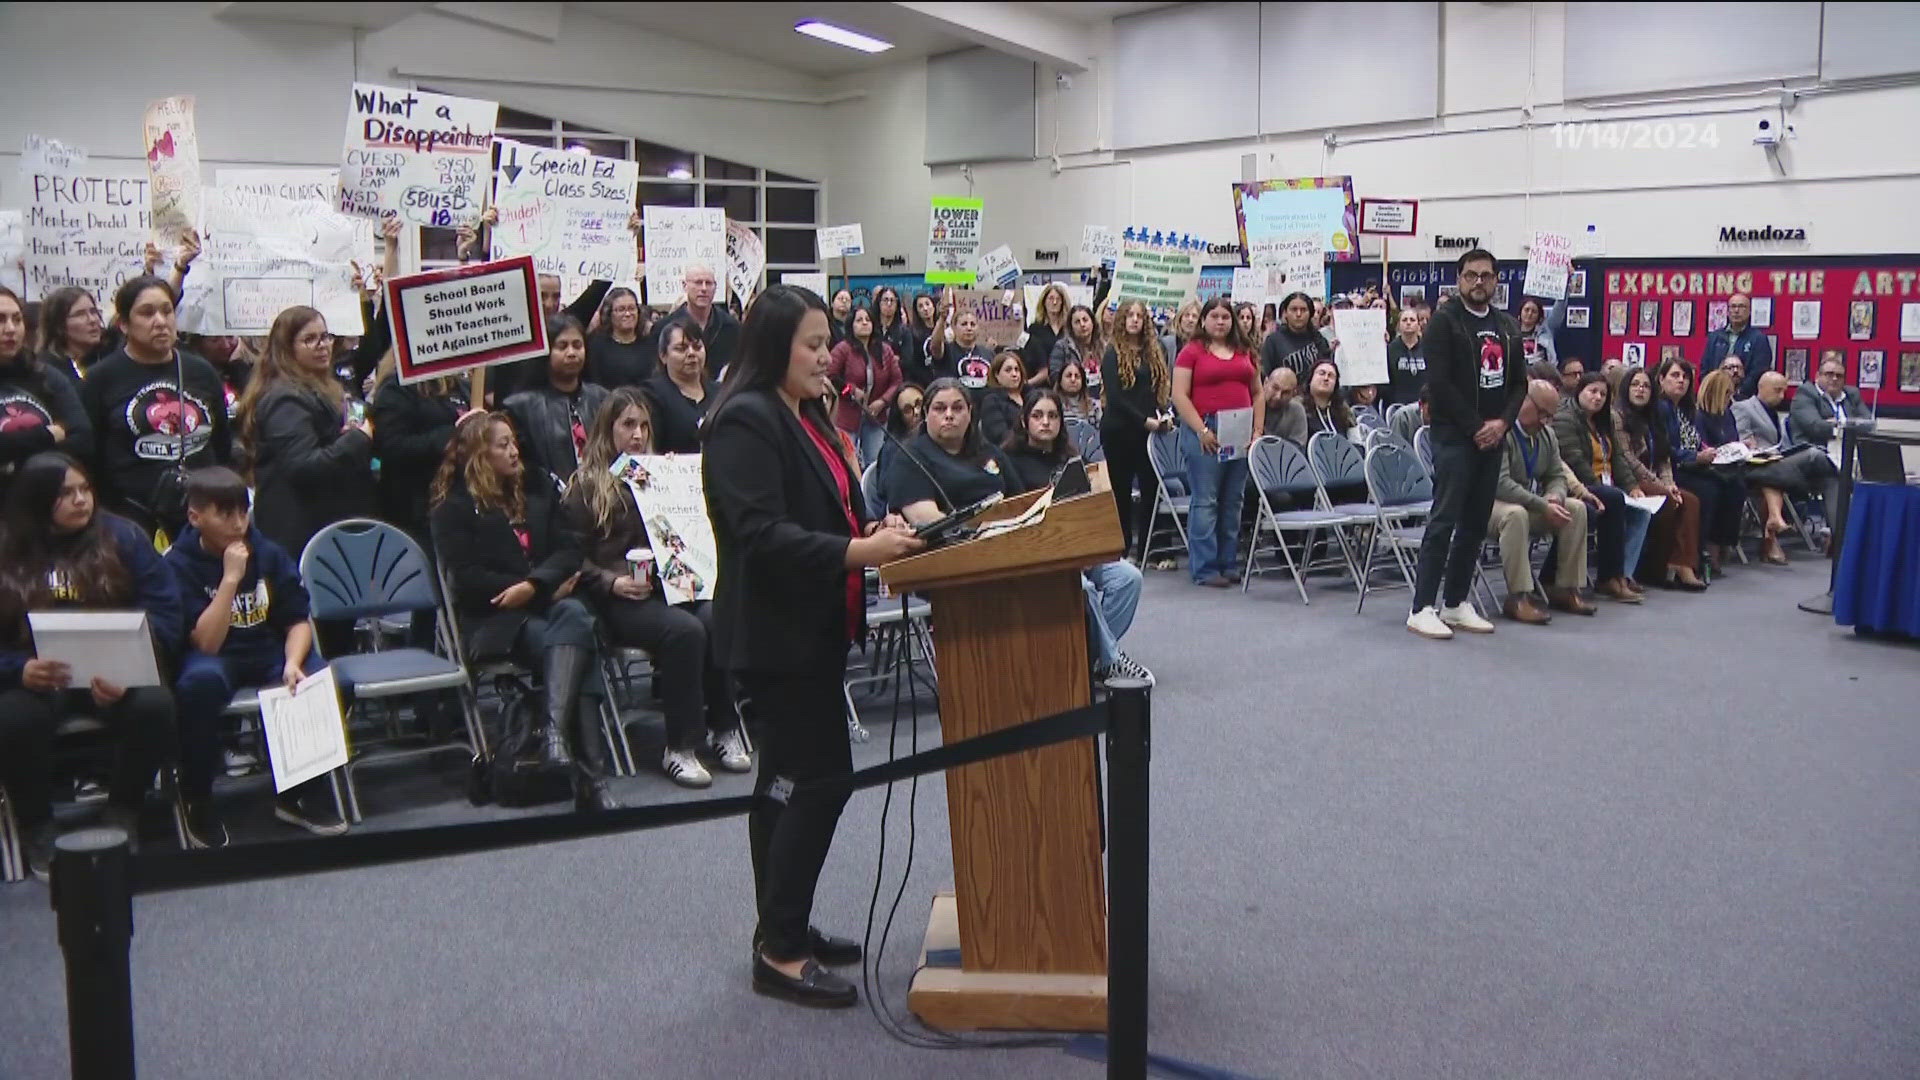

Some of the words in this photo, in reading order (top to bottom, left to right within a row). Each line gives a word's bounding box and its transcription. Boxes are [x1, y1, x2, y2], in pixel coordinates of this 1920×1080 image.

[354, 89, 418, 119] What
[435, 105, 452, 121] a
[364, 118, 494, 153] Disappointment
[347, 150, 406, 166] CVESD
[530, 152, 586, 179] Special
[34, 174, 148, 206] PROTECT
[545, 179, 585, 199] Class
[590, 181, 632, 204] Sizes!
[431, 209, 451, 226] 18
[934, 207, 979, 220] LOWER
[948, 219, 975, 228] CLASS
[950, 229, 969, 238] SIZE
[1434, 235, 1480, 250] Emory
[1719, 225, 1806, 242] Mendoza
[1207, 242, 1241, 254] Centra
[1275, 241, 1313, 251] EDUCATION
[578, 260, 619, 280] CAPS!
[424, 287, 467, 304] School
[470, 281, 505, 296] Board
[1608, 270, 1753, 295] EXPLORING
[1769, 270, 1825, 296] THE
[1852, 270, 1920, 296] ART
[429, 303, 472, 320] Should
[475, 298, 506, 312] Work
[976, 305, 1014, 321] MILK
[426, 322, 452, 337] with
[455, 314, 512, 331] Teachers,
[417, 343, 439, 356] Not
[442, 333, 489, 351] Against
[491, 325, 525, 339] Them!
